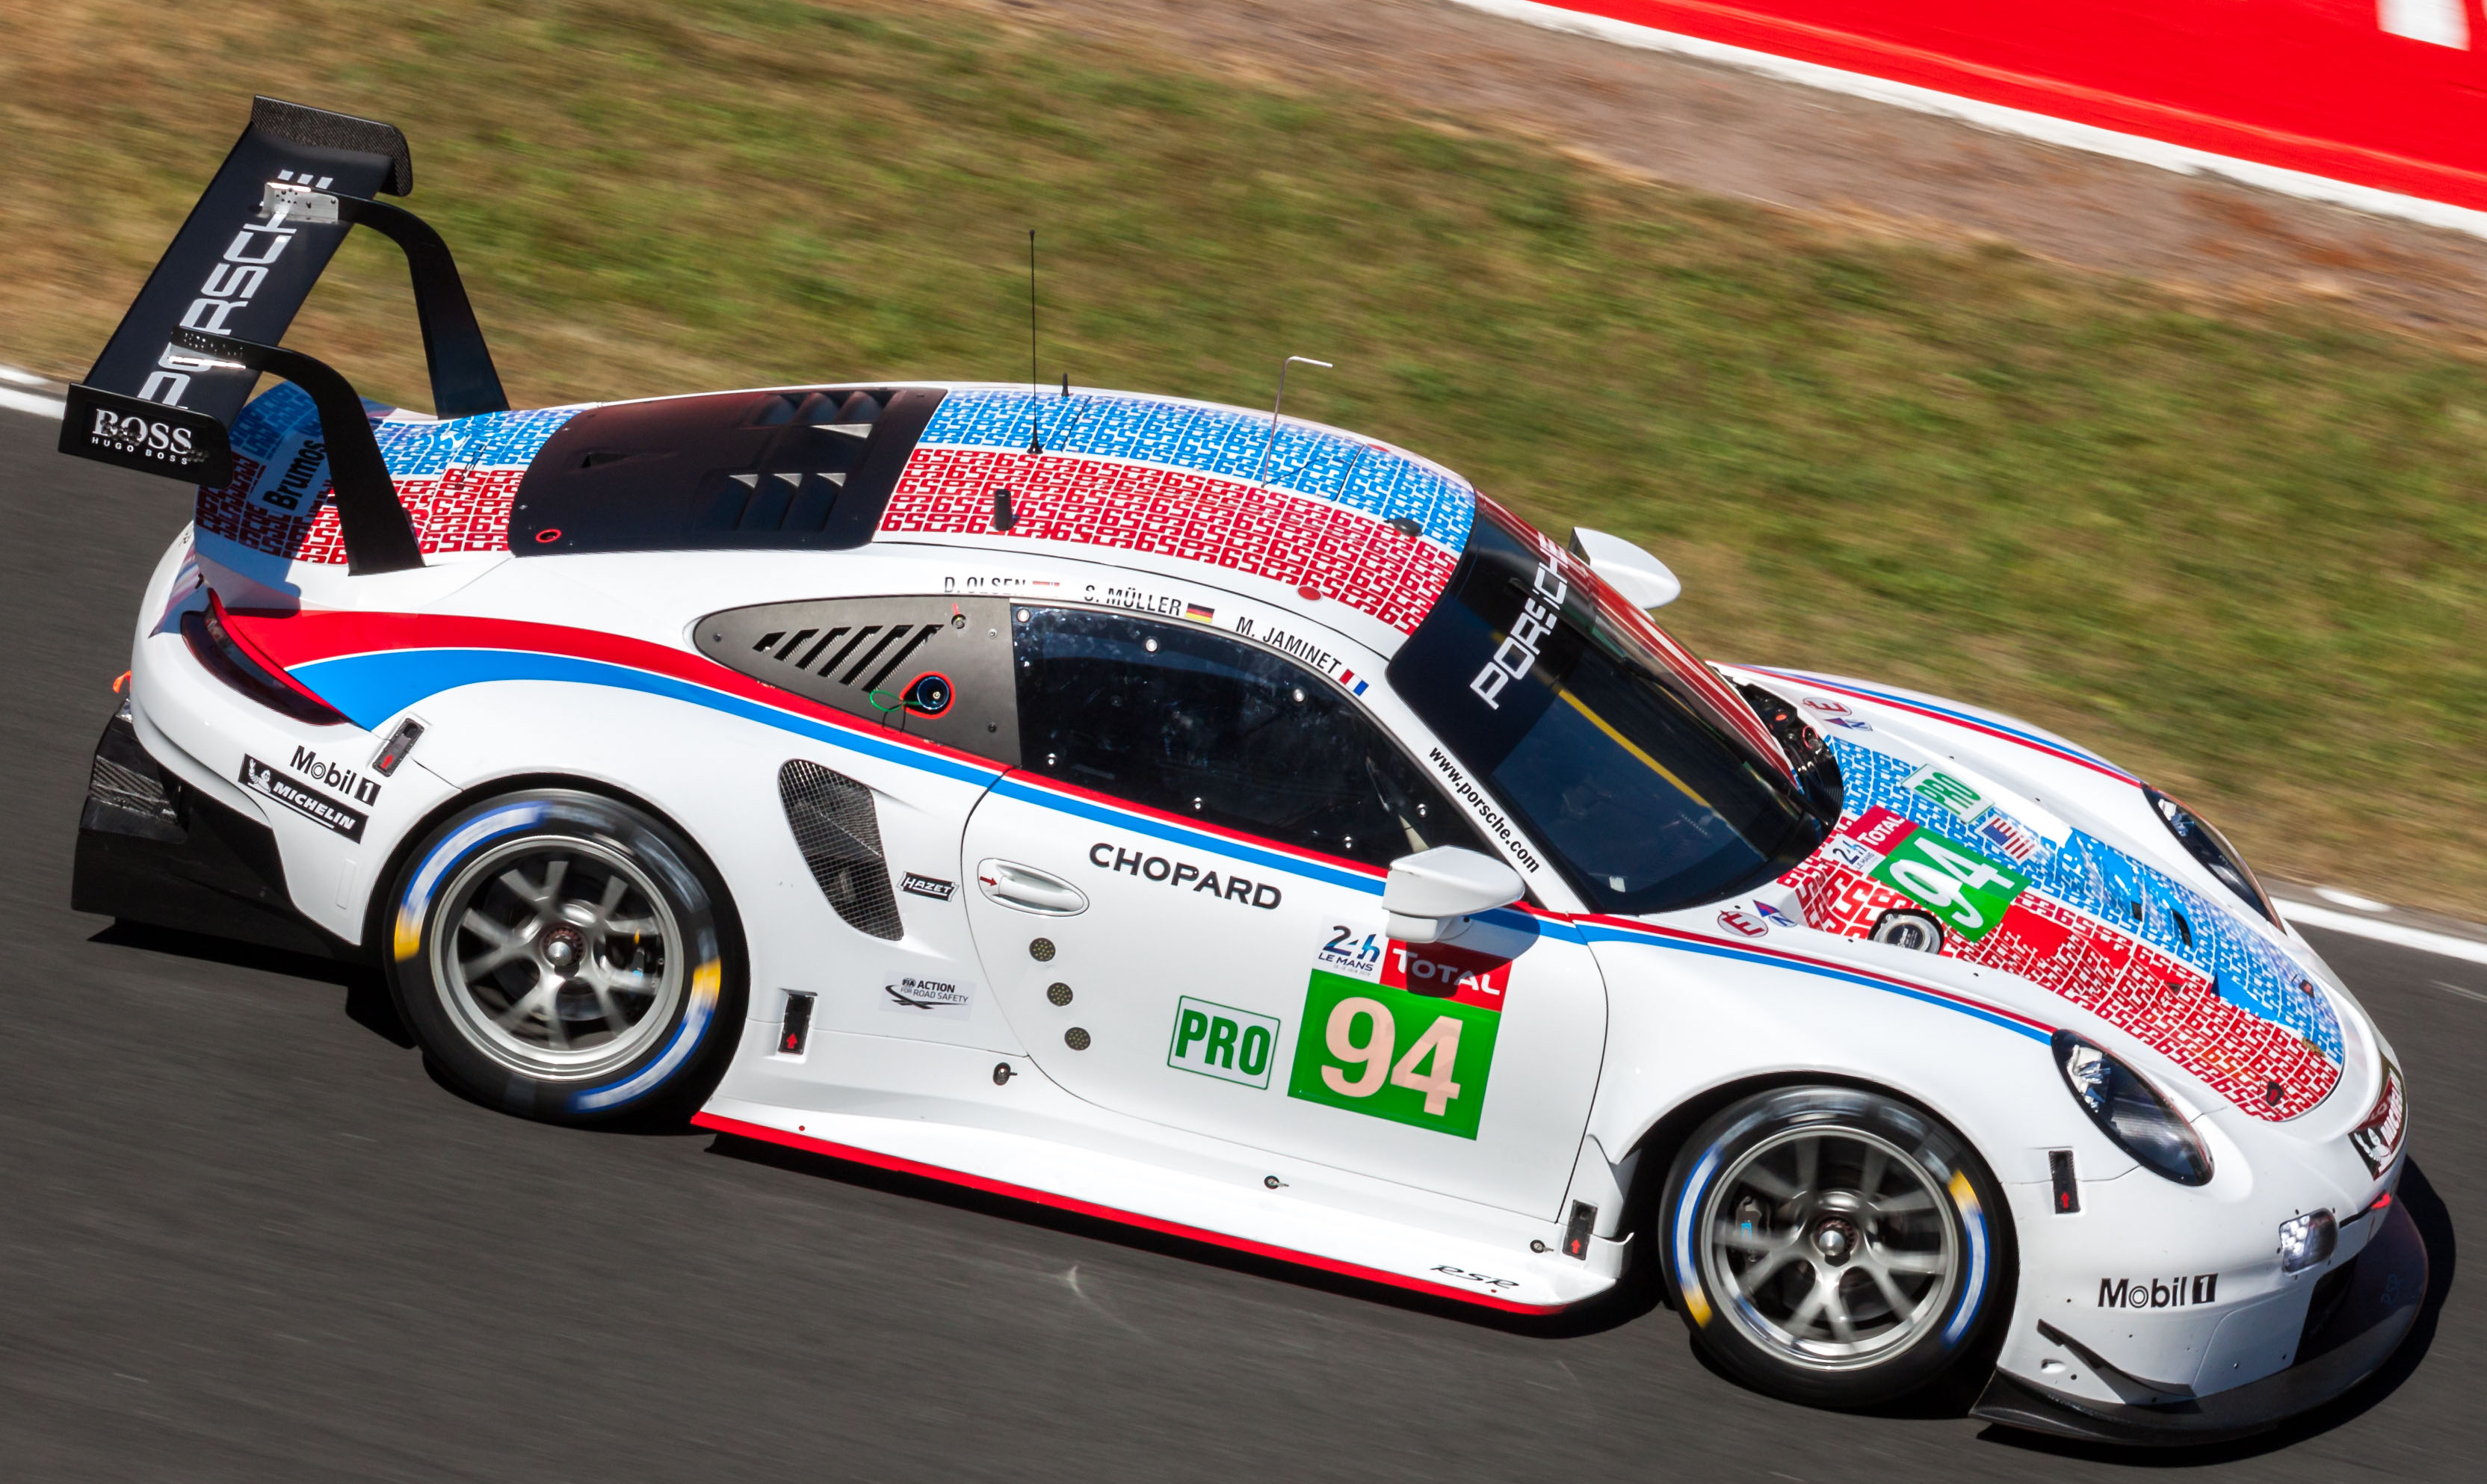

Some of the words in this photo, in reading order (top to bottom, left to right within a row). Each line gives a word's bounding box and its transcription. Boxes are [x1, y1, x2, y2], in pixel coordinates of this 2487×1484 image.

[91, 436, 135, 453] HUGO
[145, 448, 188, 465] BOSS
[92, 408, 192, 454] BOSS
[262, 439, 327, 511] Brumos
[1084, 584, 1099, 603] S.
[1106, 587, 1182, 616] MÜLLER
[1236, 615, 1256, 638] M.
[1263, 626, 1342, 675] JAMINET
[289, 744, 357, 795] Mobil
[273, 781, 356, 830] MICHELIN
[1429, 747, 1540, 874] www.porsche.com
[1914, 772, 1981, 815] PRO
[1857, 816, 1906, 846] TOTAL
[903, 877, 952, 894] HAZET
[1089, 842, 1282, 911] CHOPARD
[1889, 836, 2015, 929] 94
[1318, 952, 1335, 962] LE
[1336, 956, 1374, 971] MANS
[1392, 947, 1501, 996] TOTAL
[902, 978, 916, 987] FIA
[917, 980, 956, 993] ACTION
[913, 989, 936, 999] ROAD
[937, 992, 969, 1003] SAFETY
[1175, 1009, 1272, 1076] PRO
[1320, 997, 1464, 1117] 94
[1430, 1264, 1520, 1290] RSR
[2097, 1276, 2188, 1308] Mobil
